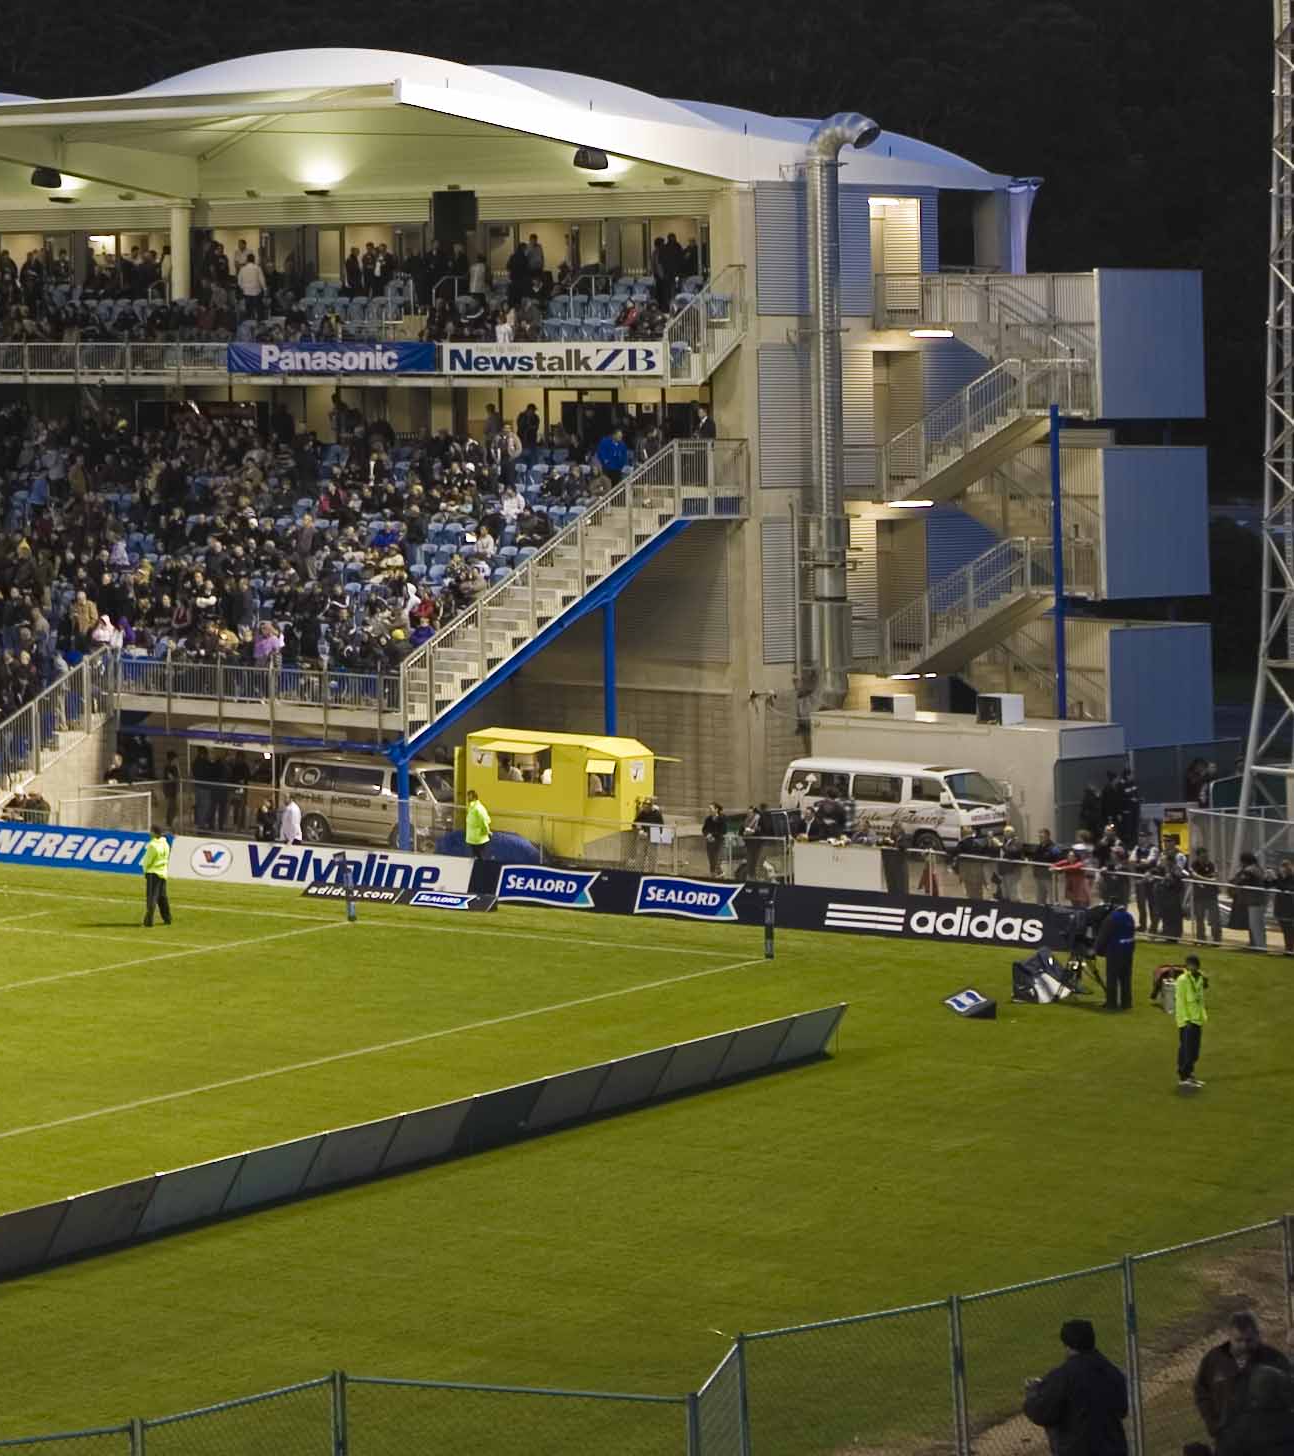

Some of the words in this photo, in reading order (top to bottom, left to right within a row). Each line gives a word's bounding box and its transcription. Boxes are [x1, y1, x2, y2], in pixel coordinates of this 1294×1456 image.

[261, 345, 398, 371] Panasonic
[248, 844, 440, 892] Valvoline
[506, 874, 577, 894] SEALORD
[645, 886, 721, 907] SEALORD
[910, 907, 1044, 943] adidas
